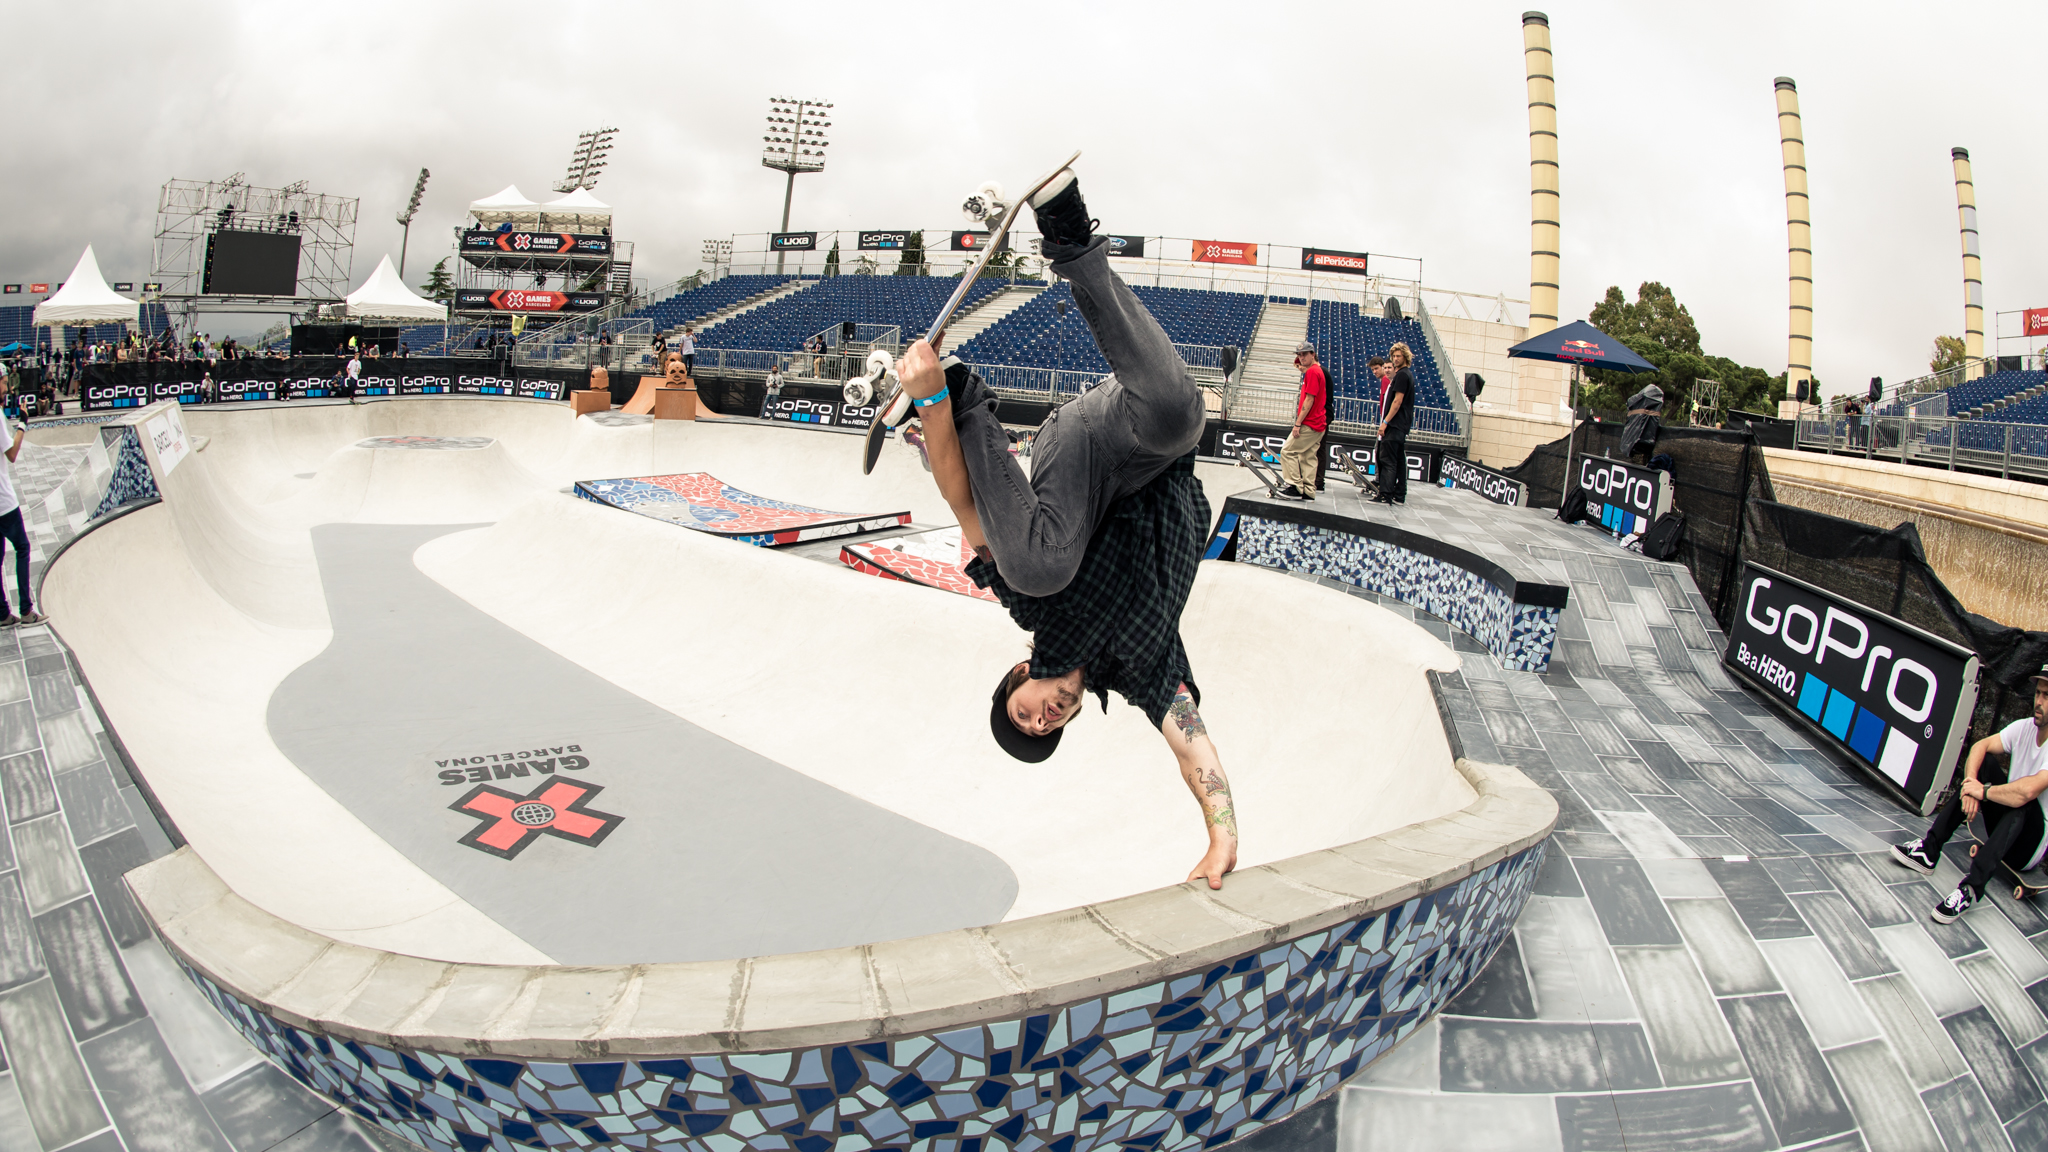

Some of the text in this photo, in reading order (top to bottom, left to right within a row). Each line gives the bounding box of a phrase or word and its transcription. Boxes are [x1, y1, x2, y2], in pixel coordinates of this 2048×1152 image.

[862, 234, 904, 242] GoPro
[1561, 345, 1583, 354] Red
[154, 382, 200, 395] GoPr
[220, 380, 276, 392] GoPro
[402, 376, 450, 386] GoPro
[459, 376, 514, 387] GoPro
[521, 380, 559, 391] GoPro
[89, 385, 147, 399] GoPro
[1441, 458, 1460, 479] GoPro
[1460, 465, 1482, 492] GoPro
[1580, 459, 1652, 510] GoPro
[1484, 474, 1517, 506] GoPro
[1586, 501, 1601, 519] HERO.
[1737, 642, 1796, 697] Be a HERO.
[434, 745, 583, 768] BARCELONA
[438, 755, 590, 786] GAMES
